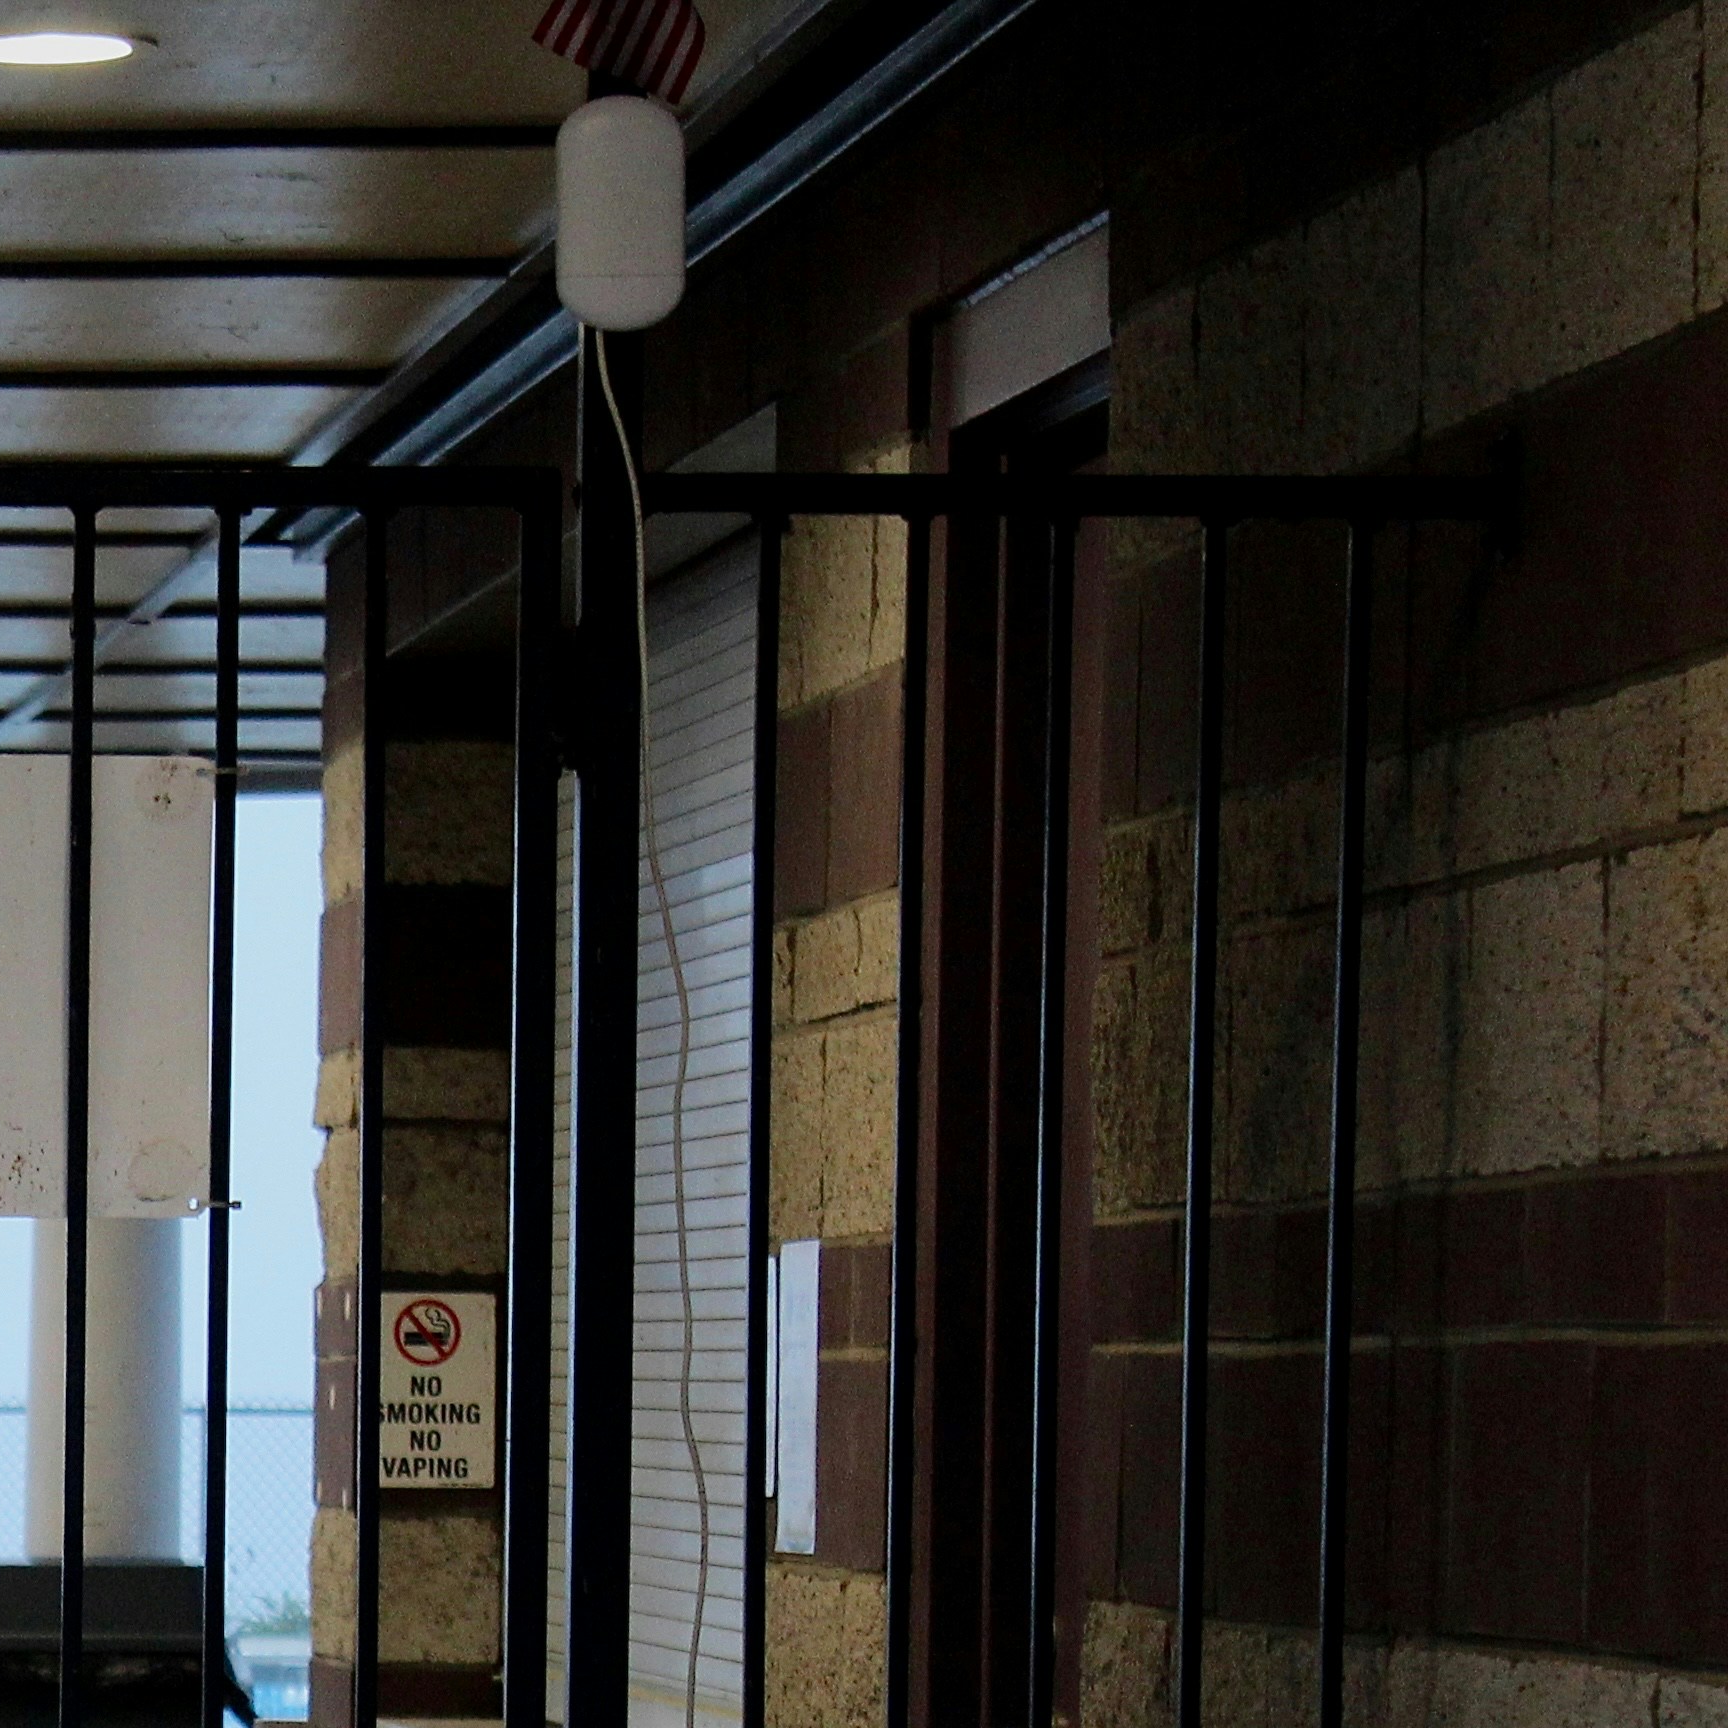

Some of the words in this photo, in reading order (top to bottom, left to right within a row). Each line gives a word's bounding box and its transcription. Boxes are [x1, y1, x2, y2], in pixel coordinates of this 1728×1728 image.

[410, 1376, 442, 1397] NO
[410, 1430, 442, 1452] NO
[382, 1457, 468, 1479] VAPING
